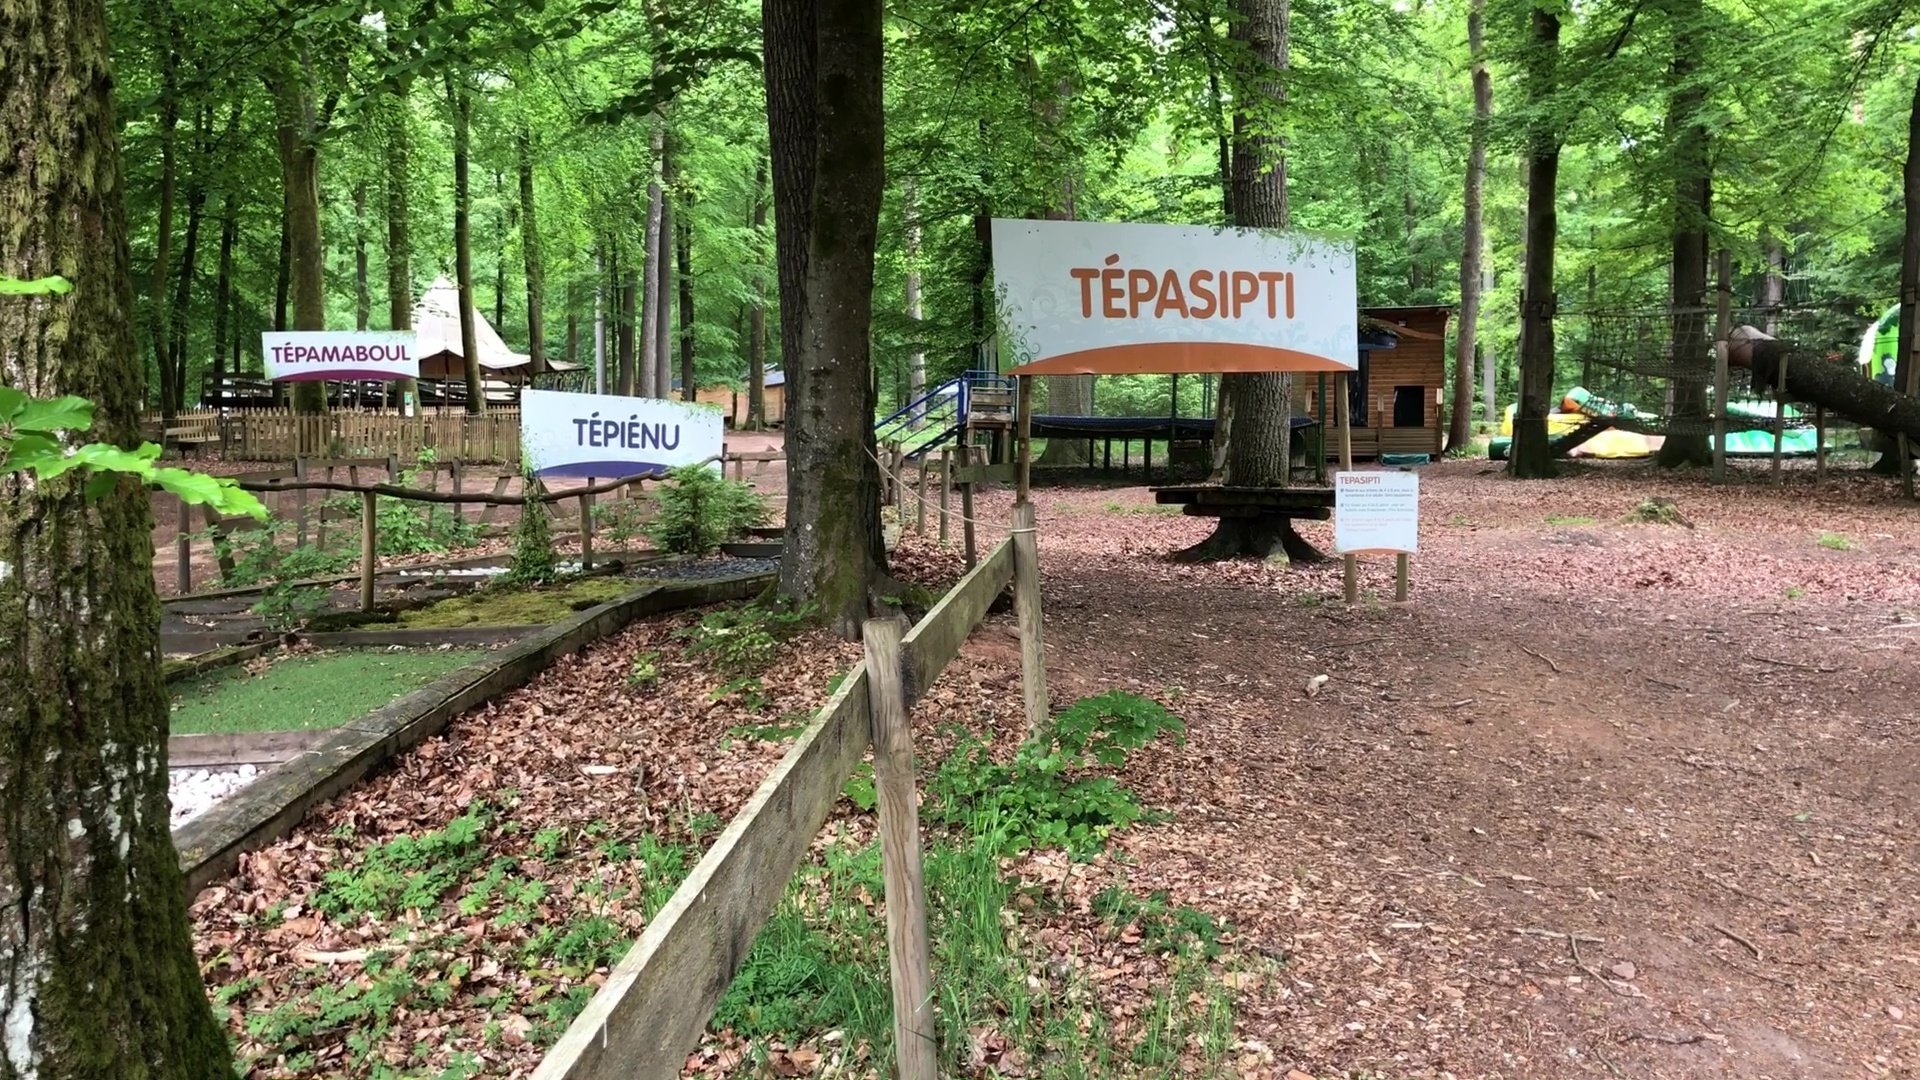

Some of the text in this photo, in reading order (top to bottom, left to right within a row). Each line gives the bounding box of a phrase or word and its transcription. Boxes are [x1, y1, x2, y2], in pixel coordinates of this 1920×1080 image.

[1070, 254, 1295, 319] TÉPASIPTI
[271, 342, 411, 364] TÉPAMABOUL
[572, 411, 680, 450] TÉPIÉNU
